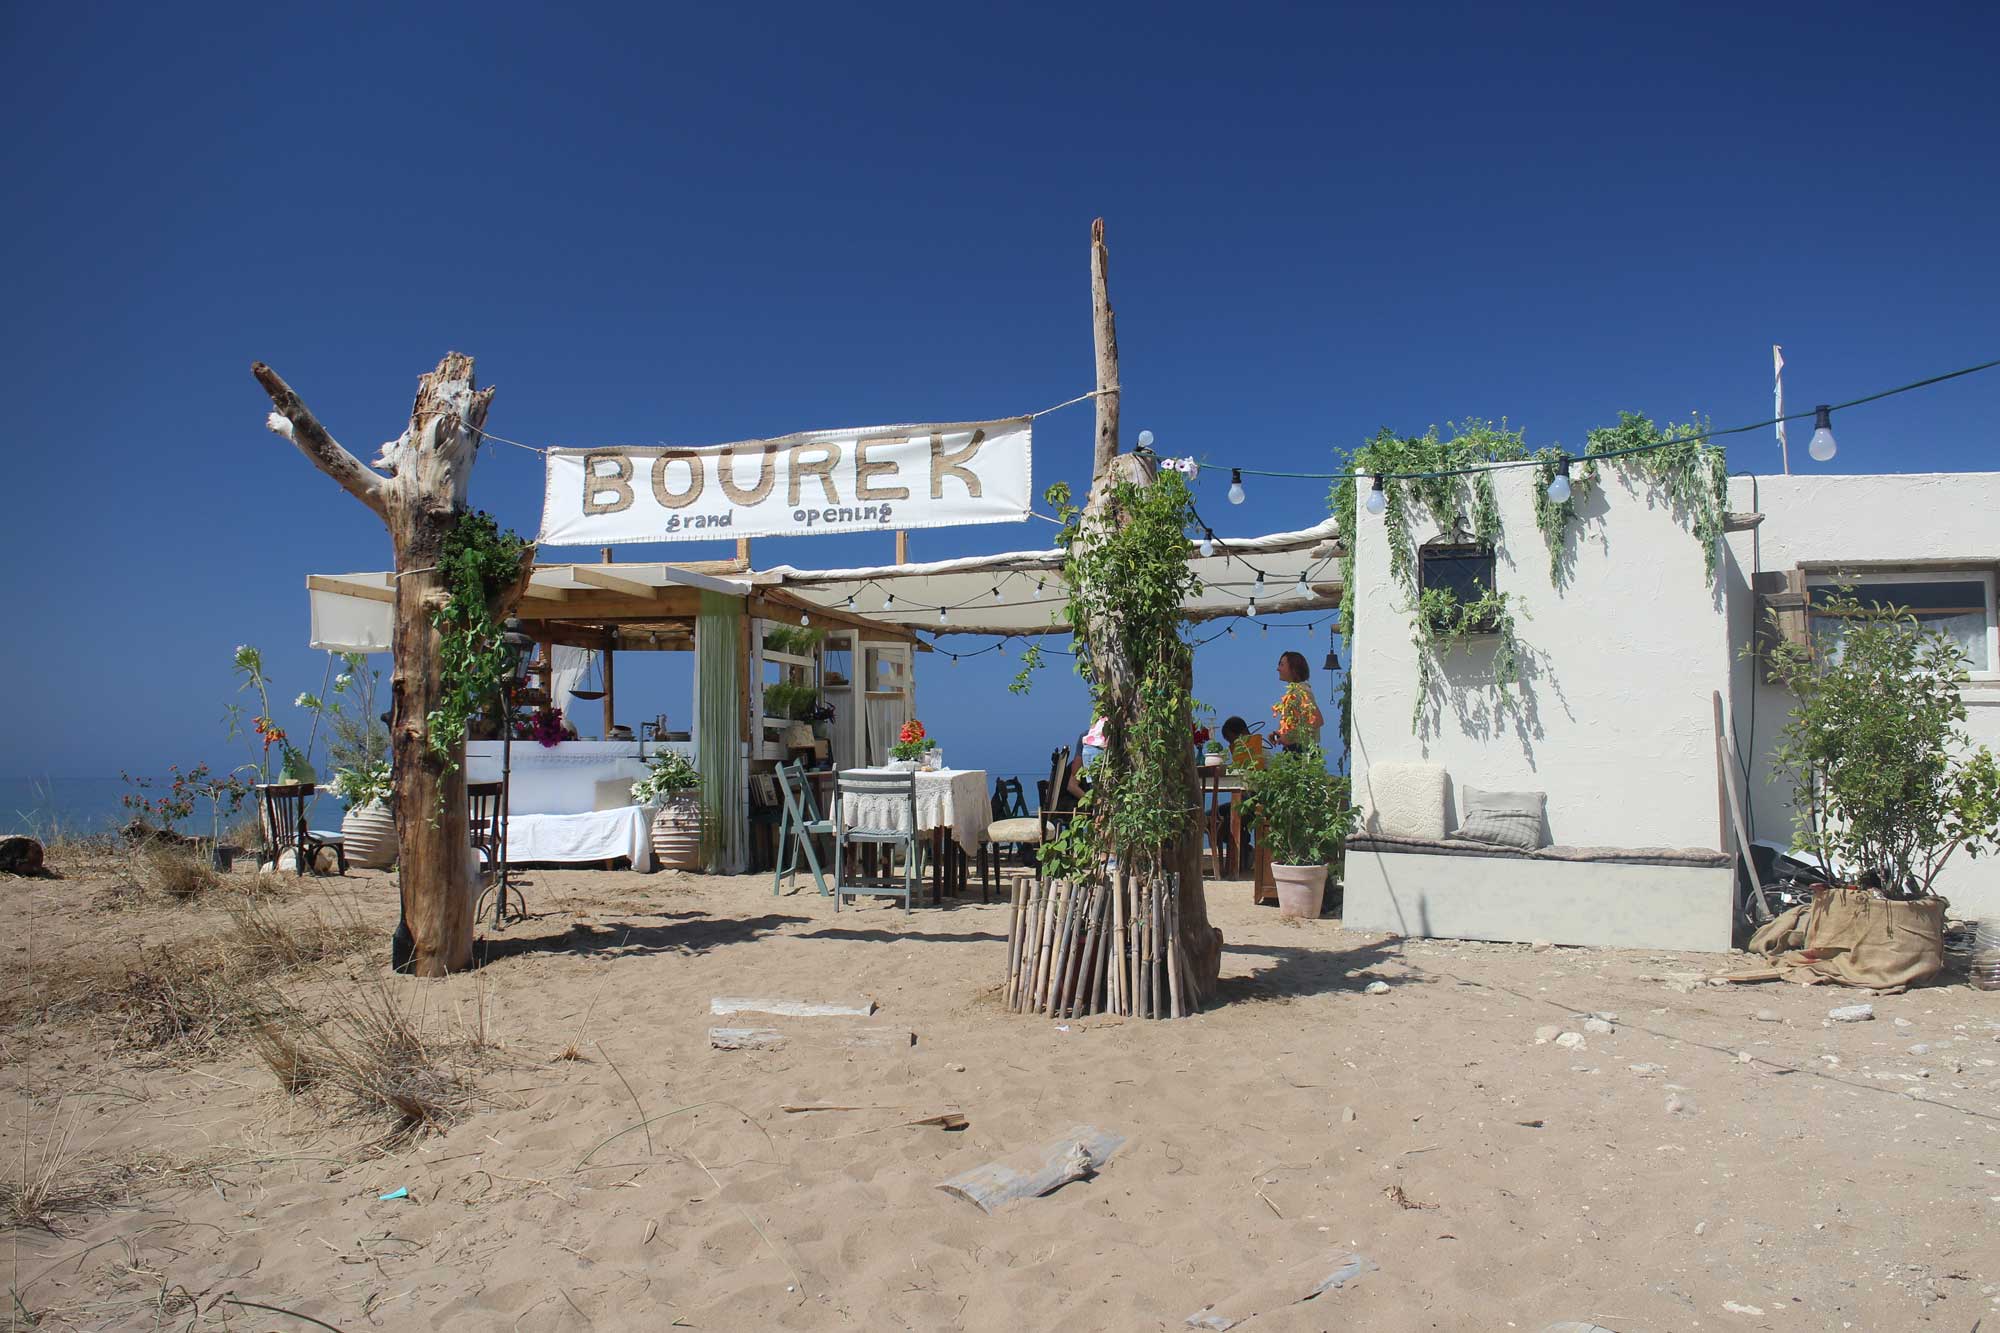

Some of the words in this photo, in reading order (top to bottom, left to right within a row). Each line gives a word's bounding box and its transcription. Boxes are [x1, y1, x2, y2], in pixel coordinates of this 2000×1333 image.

[582, 429, 986, 515] BOUREK
[666, 509, 732, 533] grand
[793, 503, 892, 526] opening
